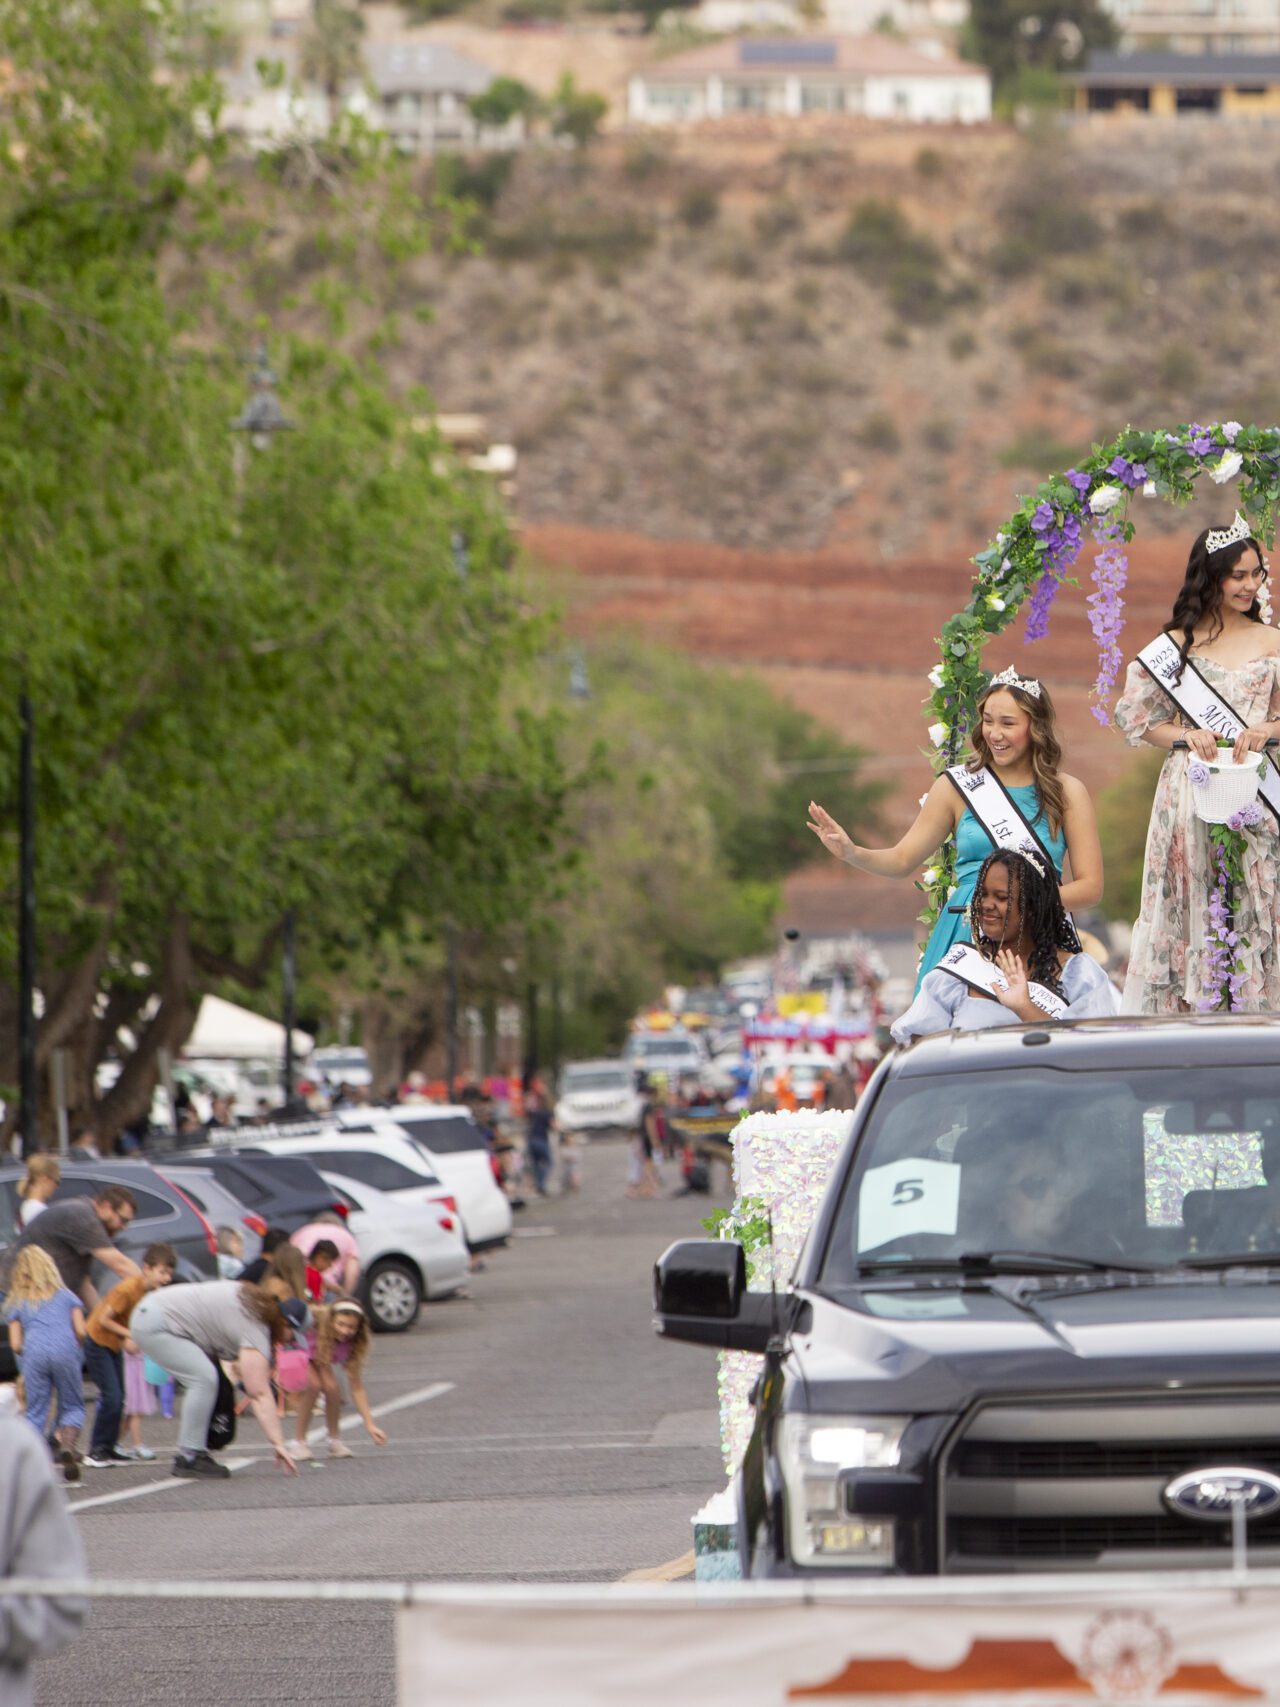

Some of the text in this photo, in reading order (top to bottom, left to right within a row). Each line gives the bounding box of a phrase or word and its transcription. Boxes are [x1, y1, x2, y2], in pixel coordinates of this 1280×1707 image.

[1150, 646, 1174, 669] 2025
[1200, 704, 1238, 739] MISS
[953, 769, 969, 780] 20
[991, 818, 1013, 840] 1st
[891, 1179, 925, 1207] 5
